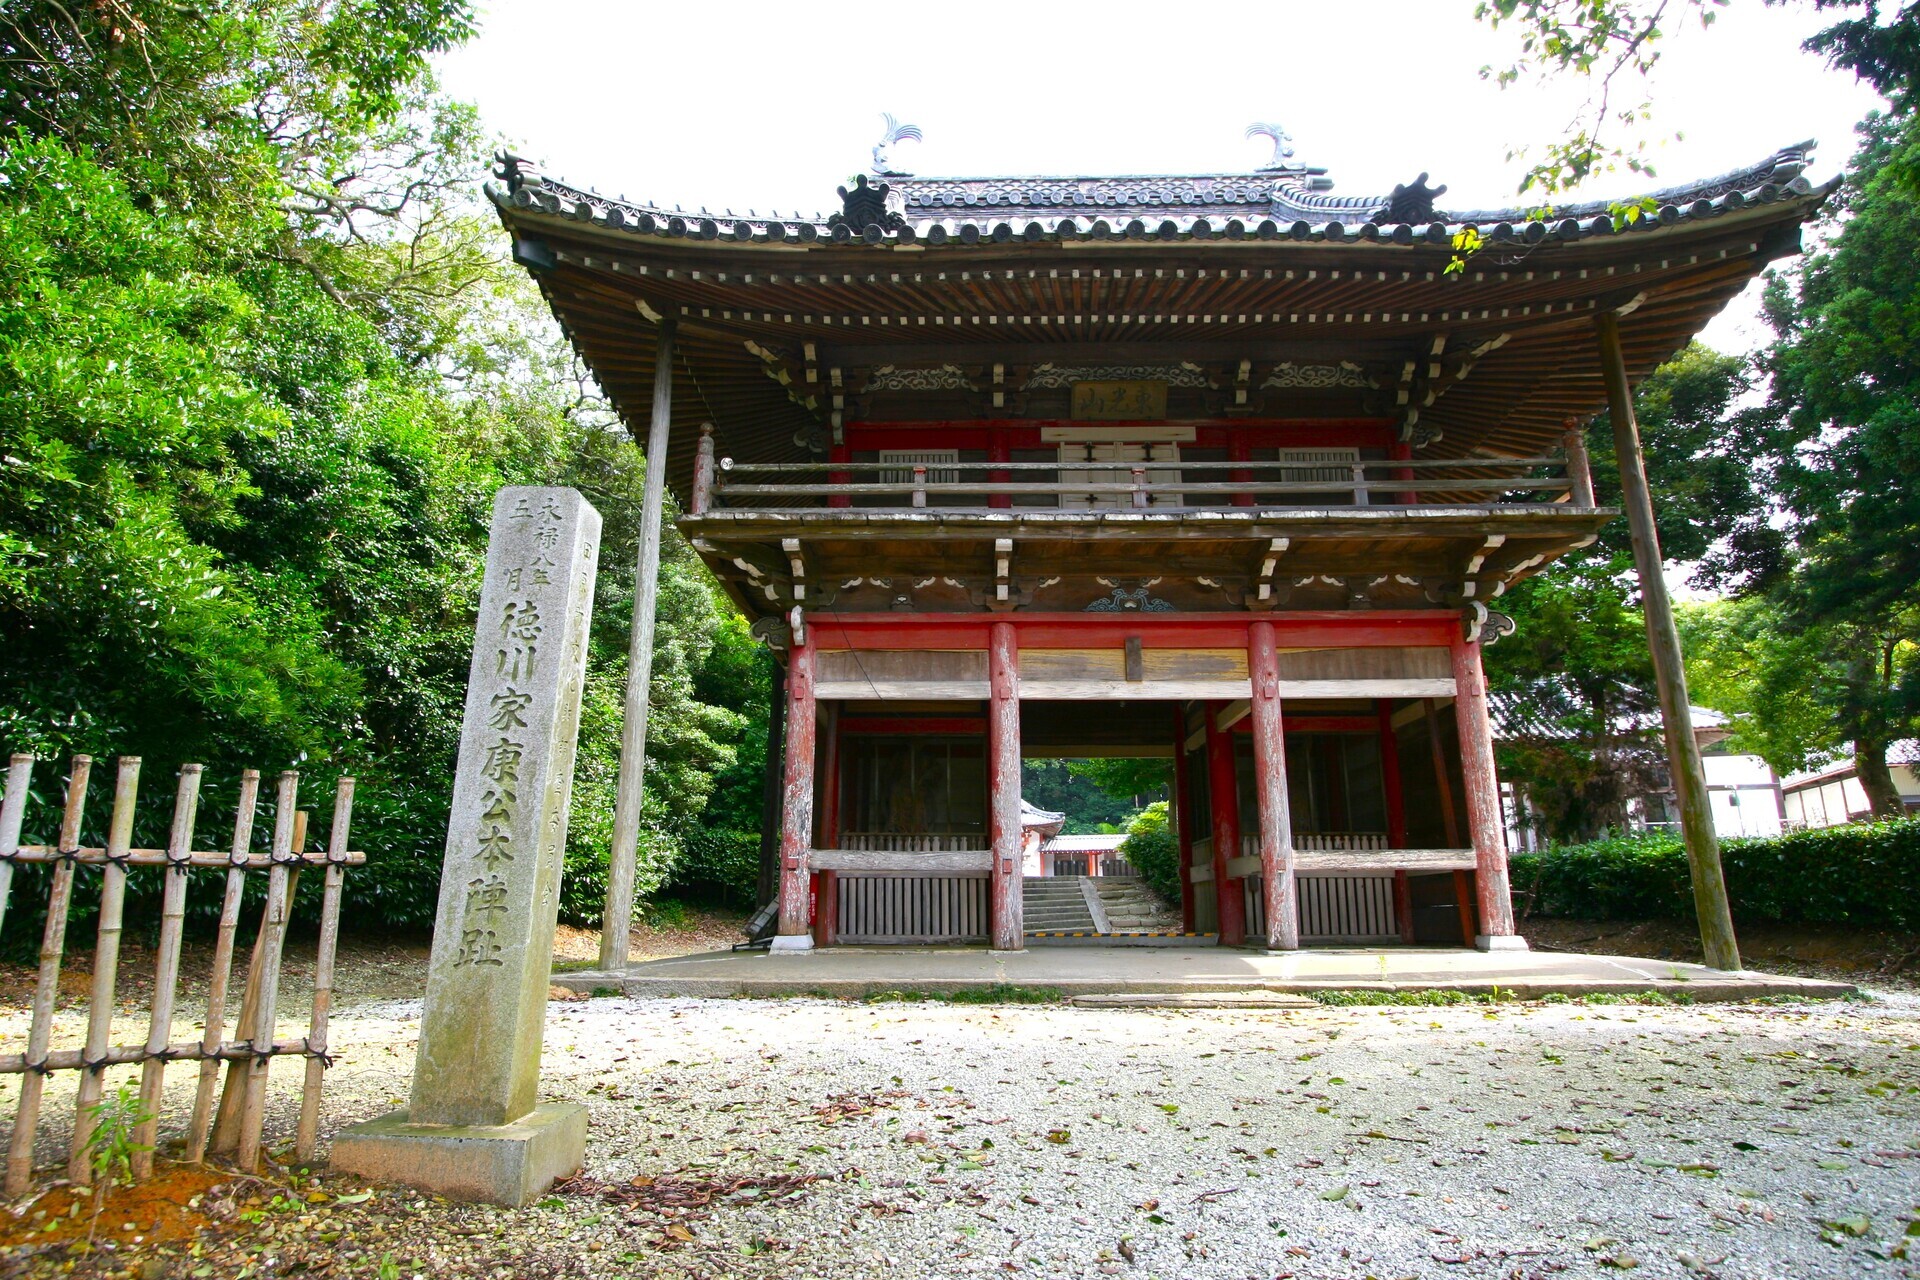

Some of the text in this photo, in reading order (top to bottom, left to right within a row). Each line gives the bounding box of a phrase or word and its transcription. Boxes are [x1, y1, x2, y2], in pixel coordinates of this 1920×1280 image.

[528, 496, 563, 594] 永禄八年
[452, 600, 543, 968] 徳川家康公本陣趾
